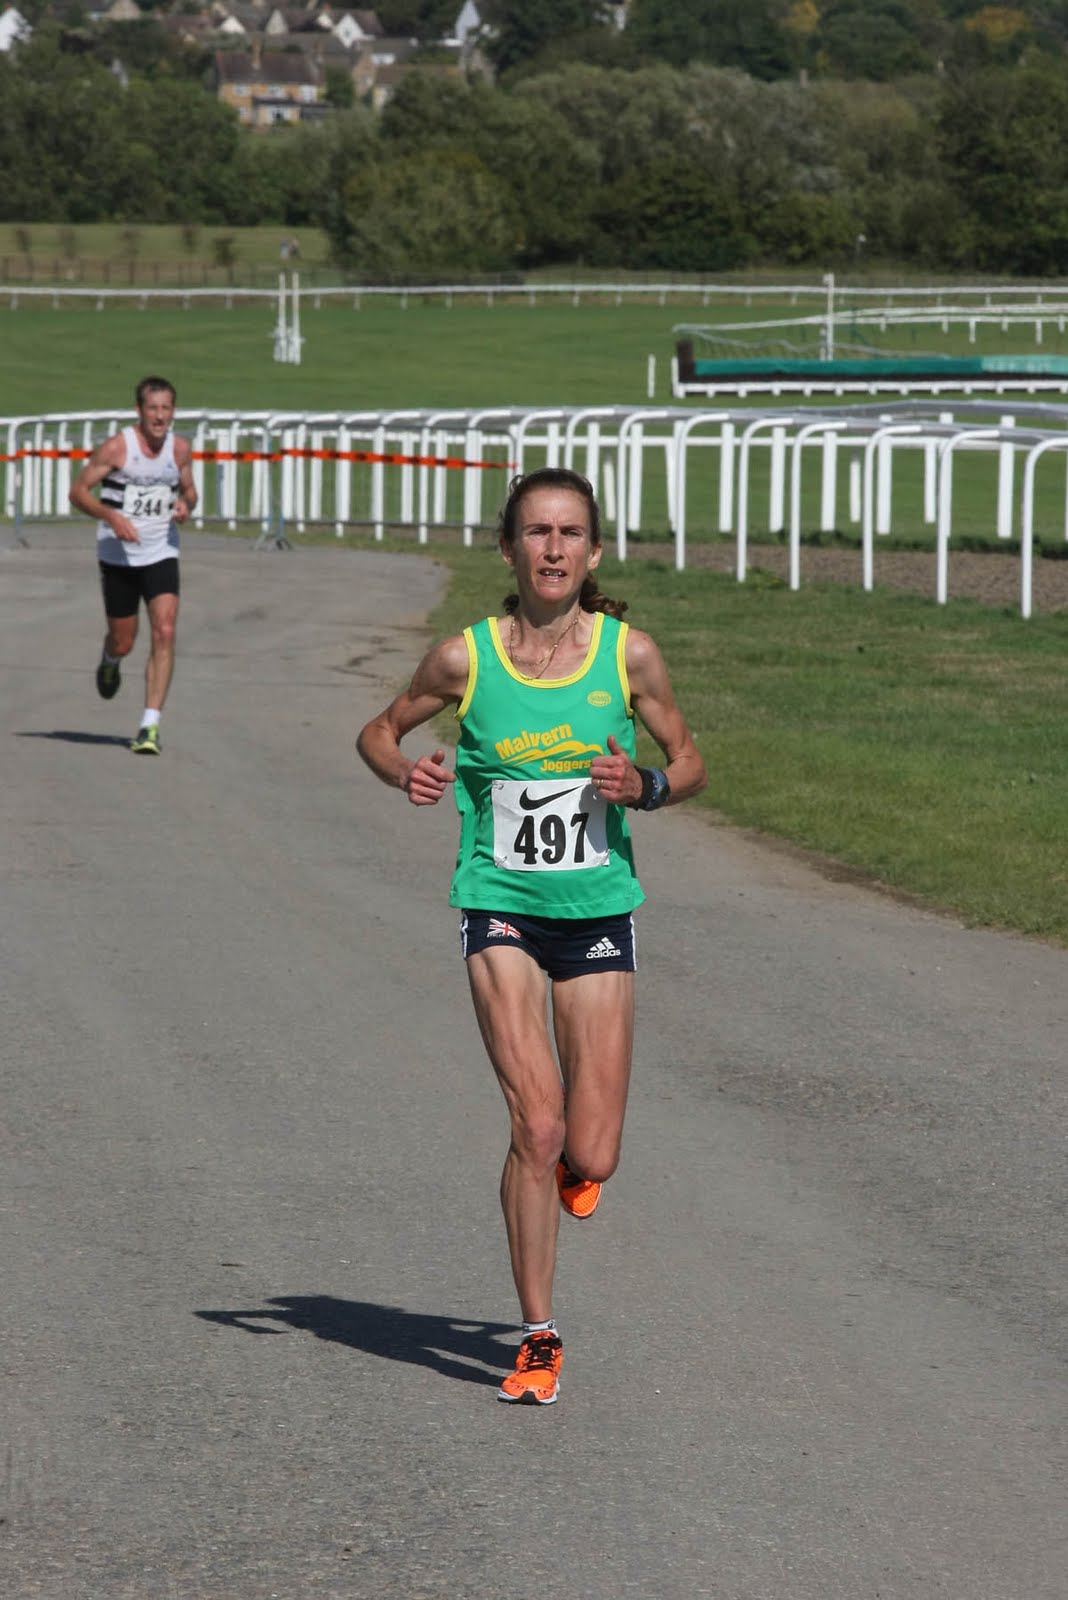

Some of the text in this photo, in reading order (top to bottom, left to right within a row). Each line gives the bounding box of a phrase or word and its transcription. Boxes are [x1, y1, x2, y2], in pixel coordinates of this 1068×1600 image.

[133, 499, 162, 516] 244
[495, 723, 573, 760] Malvern
[540, 759, 592, 773] Joggers
[514, 812, 590, 865] 497
[586, 948, 622, 959] adidas
